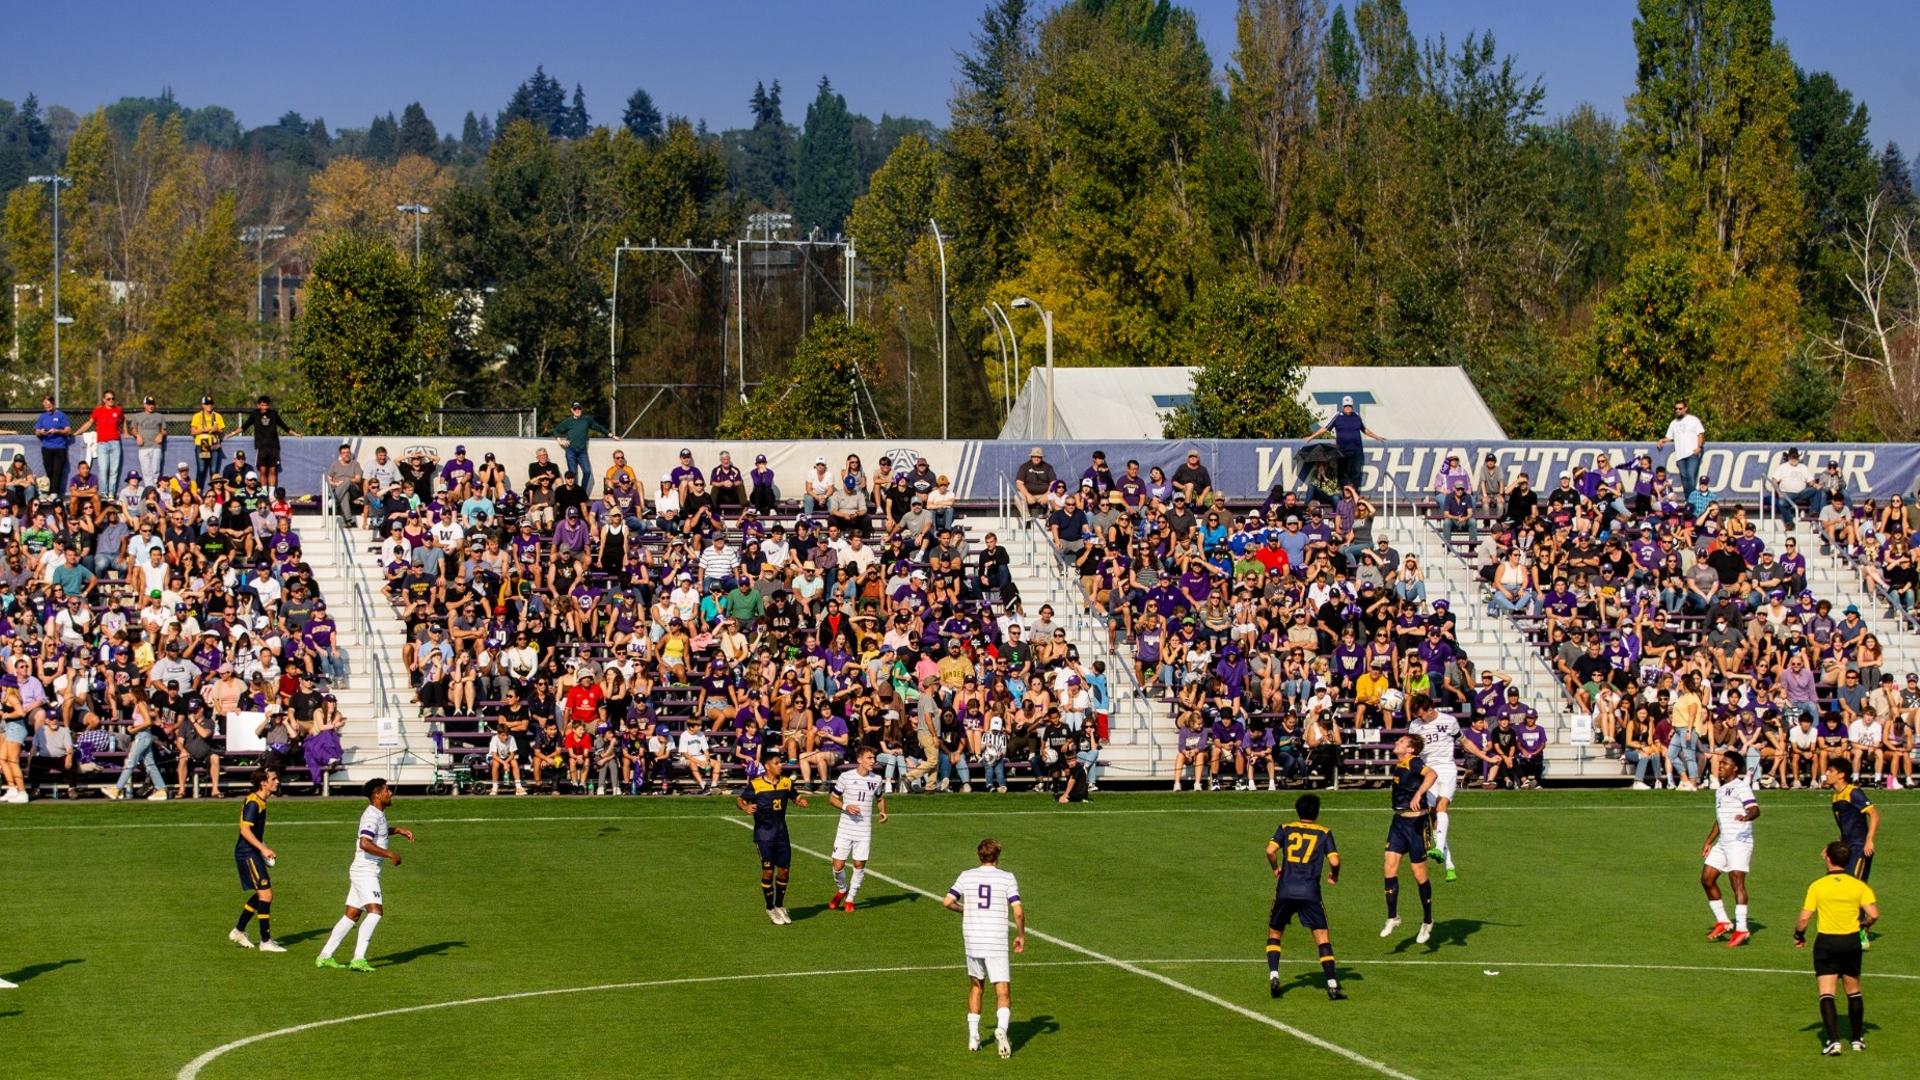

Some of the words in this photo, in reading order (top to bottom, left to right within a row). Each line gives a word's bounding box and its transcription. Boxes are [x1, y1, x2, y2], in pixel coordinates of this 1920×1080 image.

[1256, 447, 1648, 493] WSHINGTON
[126, 496, 140, 506] W
[440, 530, 453, 541] W
[1341, 656, 1358, 669] W
[1436, 725, 1448, 733] W
[1425, 733, 1439, 744] 33
[866, 782, 877, 791] W
[857, 791, 866, 802] 11
[772, 799, 782, 811] 21
[1287, 832, 1318, 864] 27
[978, 884, 991, 909] 9
